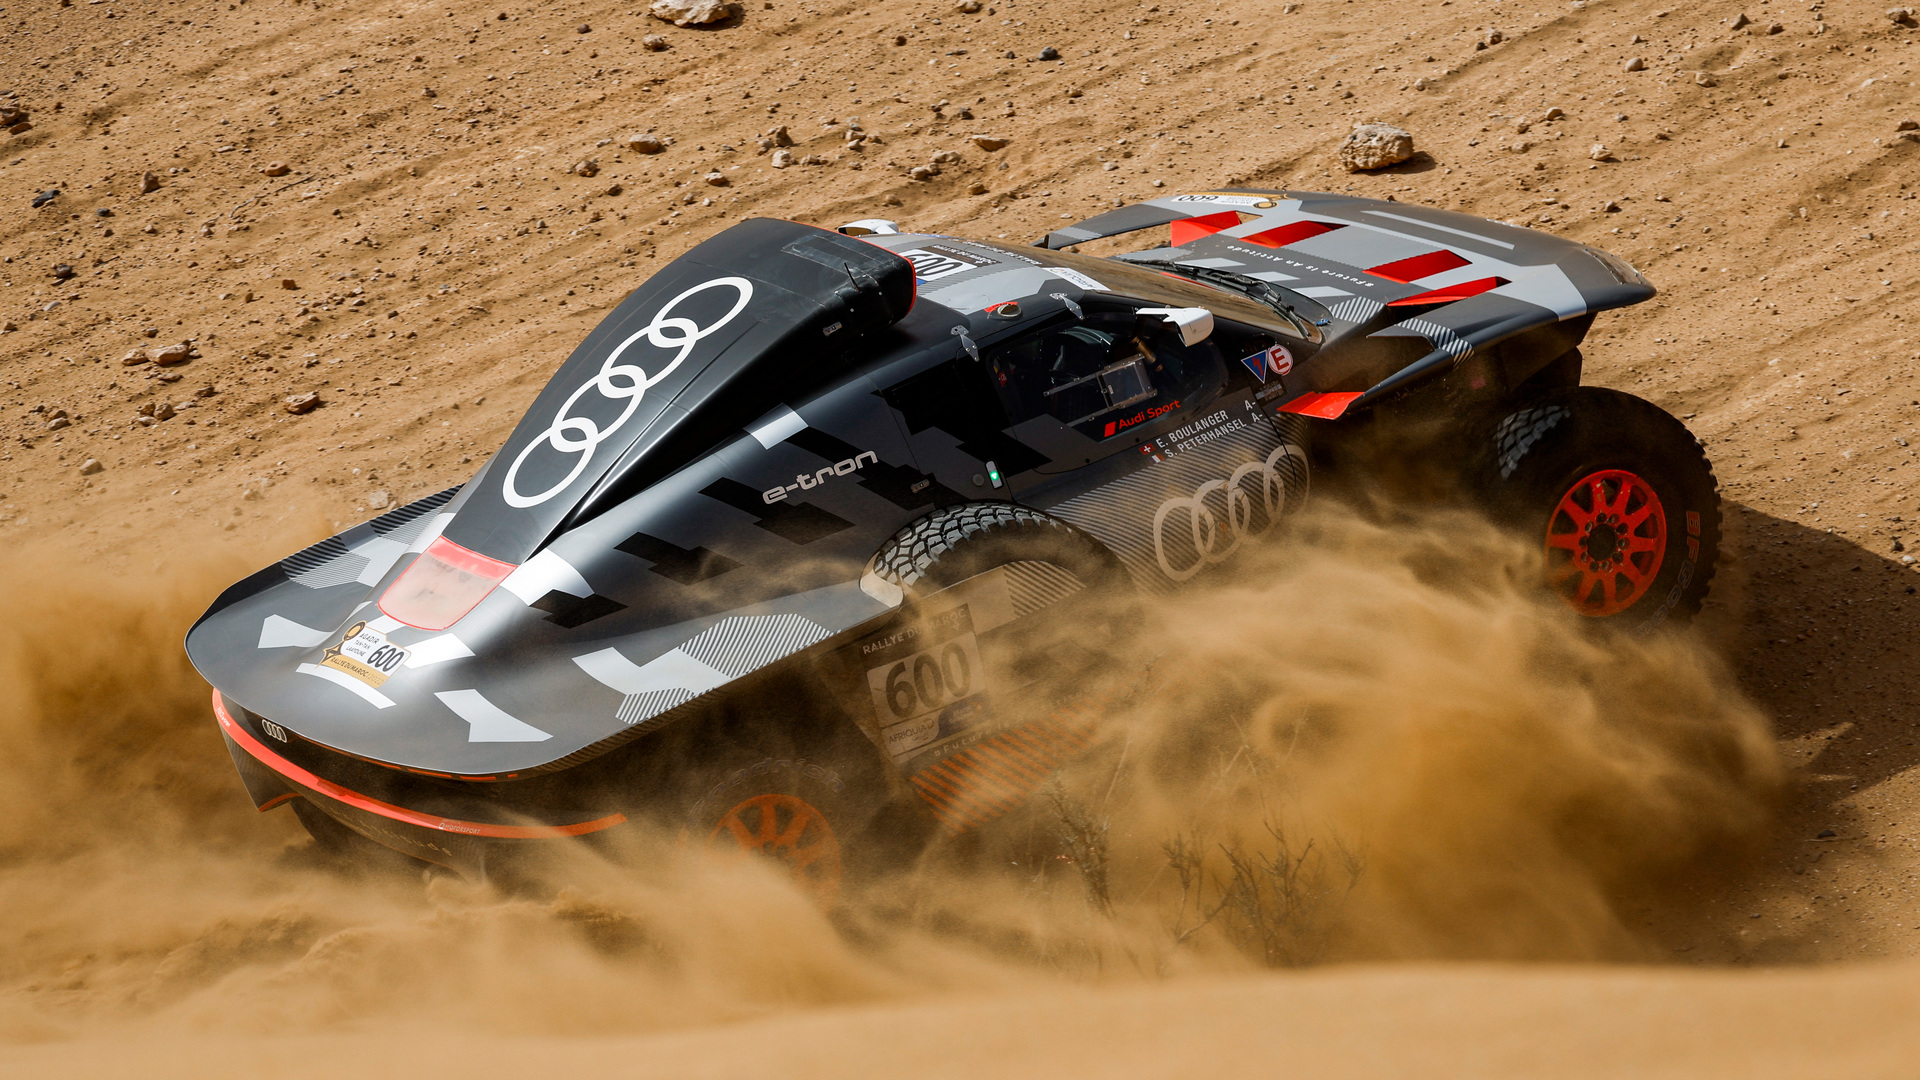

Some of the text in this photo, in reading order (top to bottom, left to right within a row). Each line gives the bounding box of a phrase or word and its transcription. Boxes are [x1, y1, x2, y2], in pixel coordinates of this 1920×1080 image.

[1270, 348, 1290, 370] E
[1118, 399, 1181, 430] Audi Sport
[1156, 437, 1169, 449] E.
[1168, 409, 1229, 443] BOULANGER
[1165, 448, 1178, 459] S.
[1177, 419, 1248, 453] PETERHANSEL
[762, 450, 879, 505] e-tron
[367, 644, 405, 673] 600
[862, 631, 905, 655] RALLYE
[886, 642, 971, 719] 600
